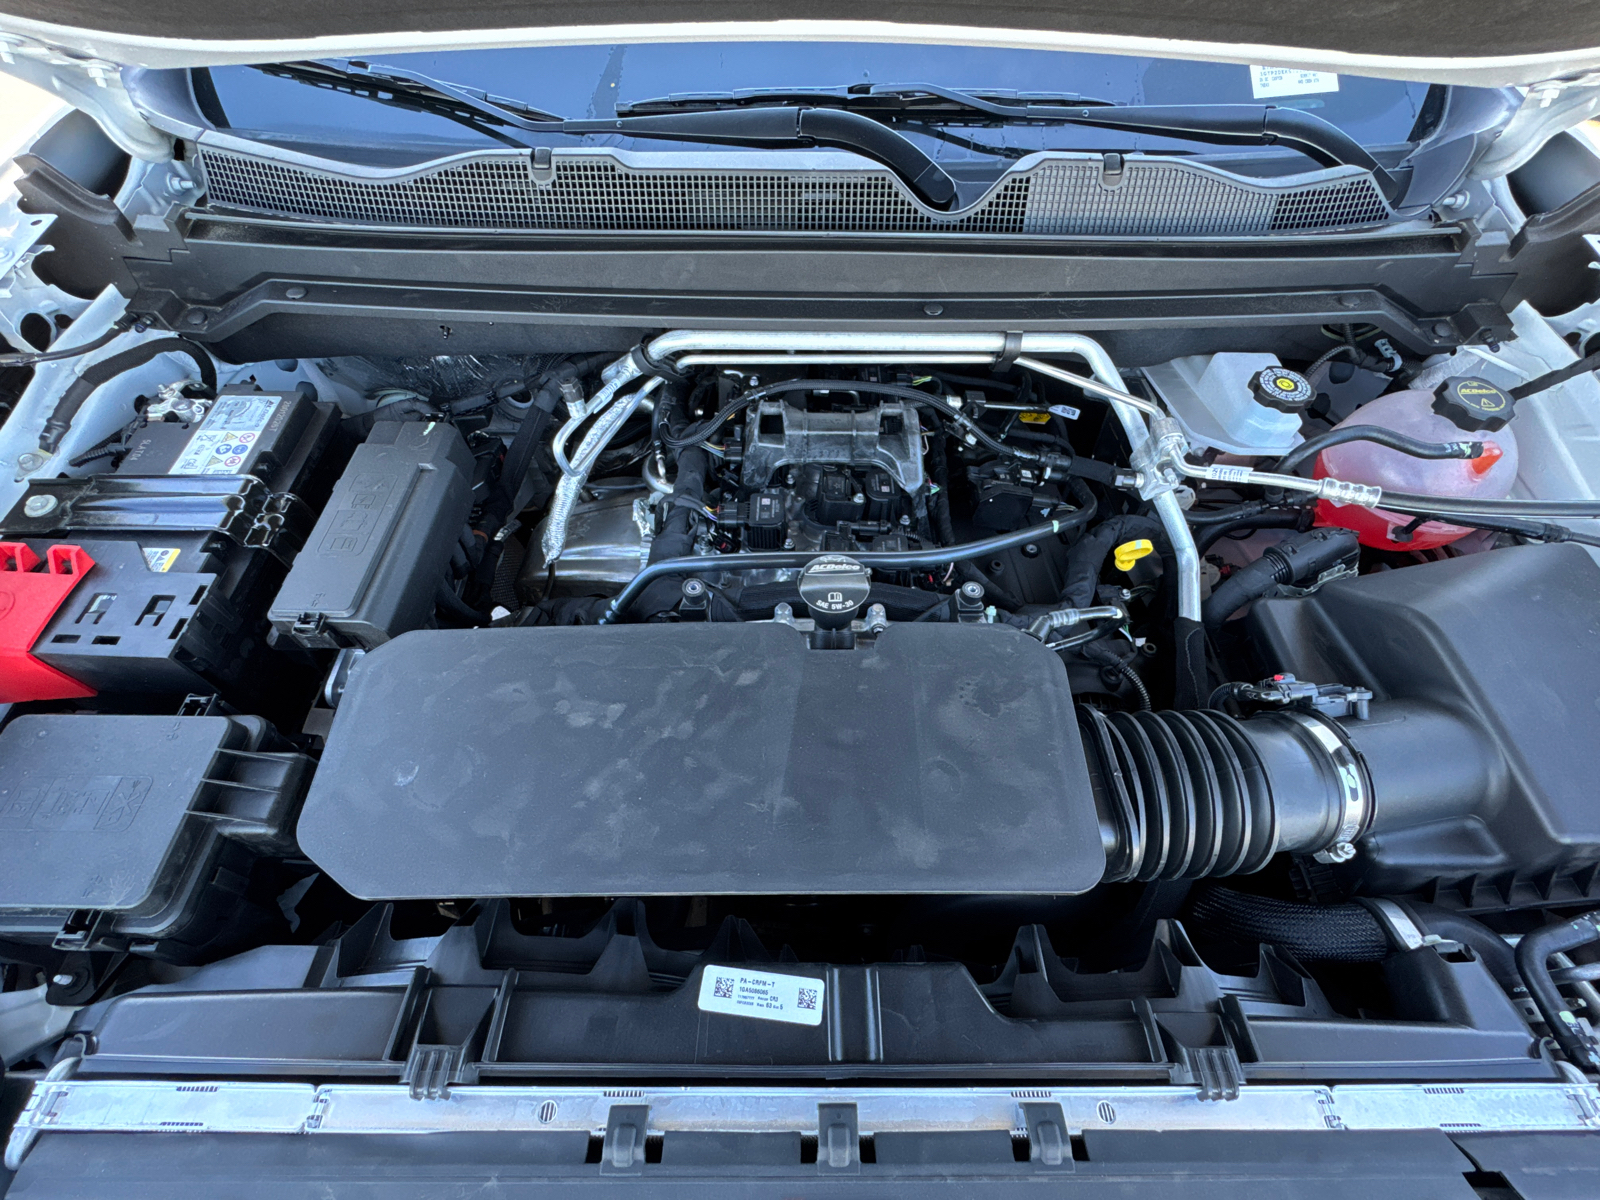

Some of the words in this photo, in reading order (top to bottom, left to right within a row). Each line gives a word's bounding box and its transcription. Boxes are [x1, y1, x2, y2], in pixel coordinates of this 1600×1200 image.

[808, 563, 861, 573] ACDelco
[816, 599, 829, 609] SAE
[831, 600, 854, 610] 5W-30
